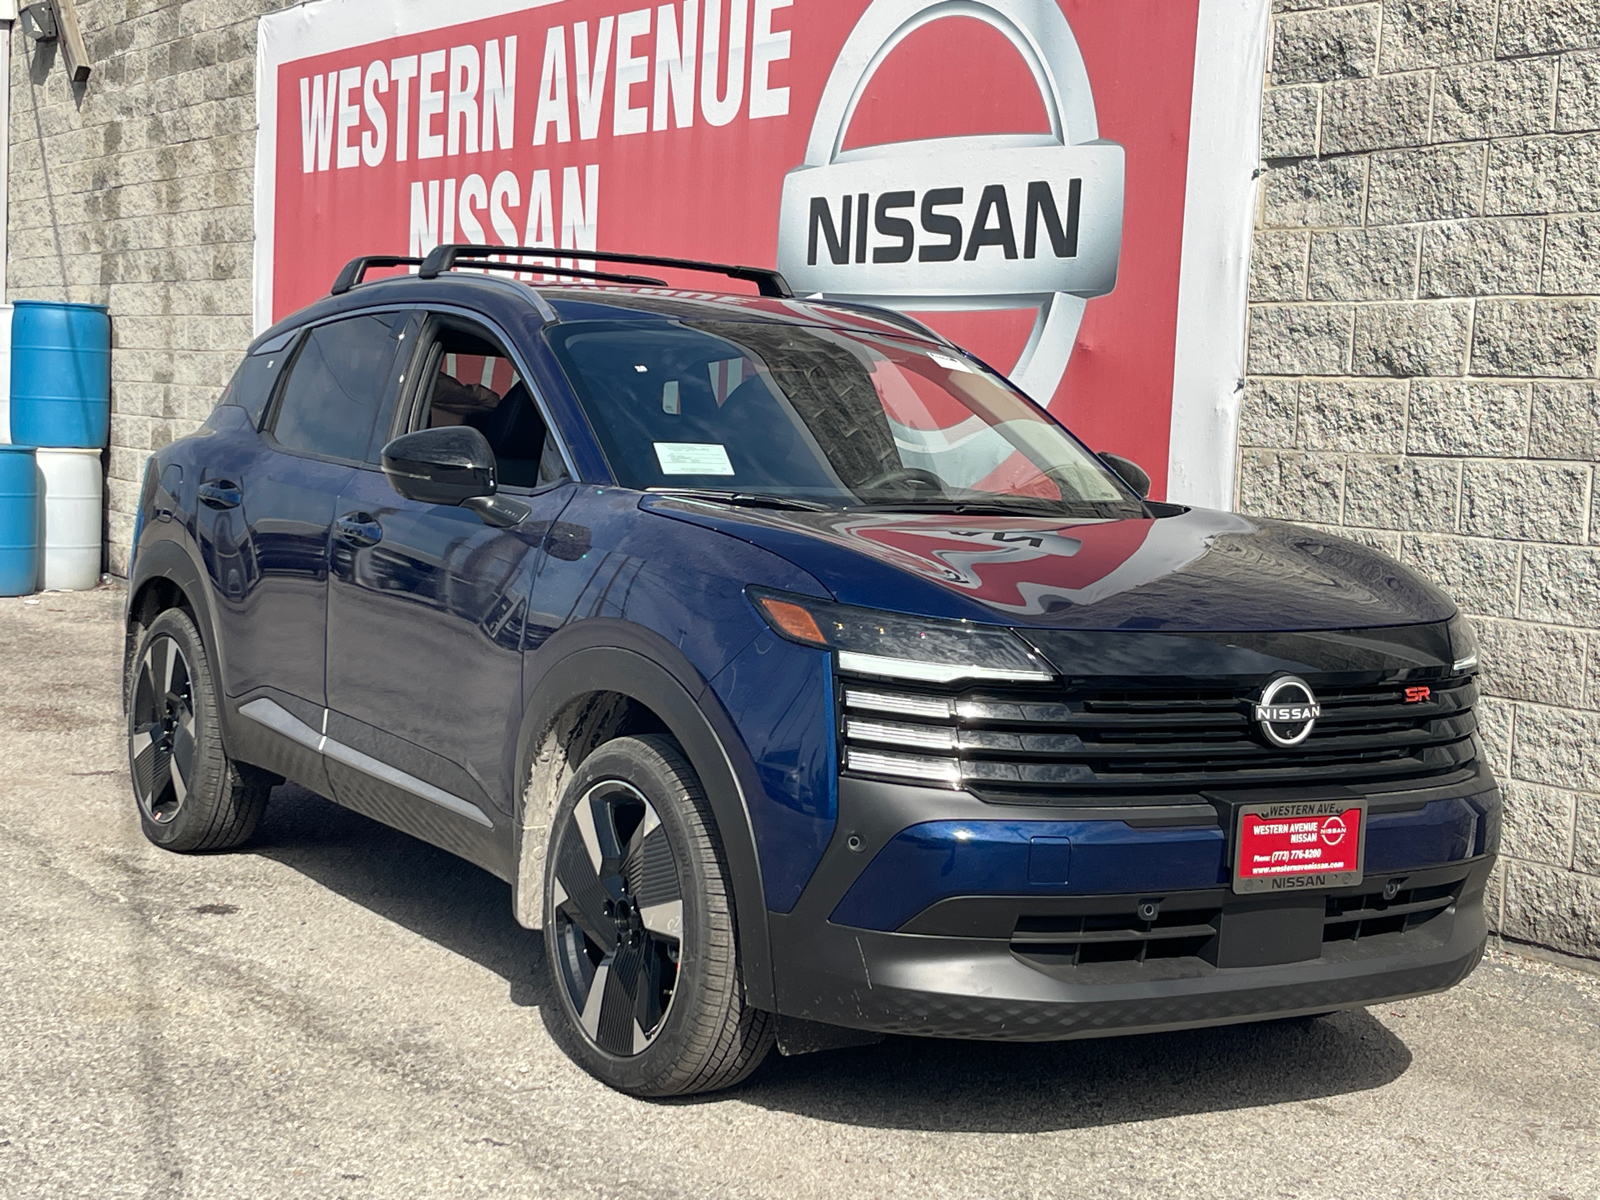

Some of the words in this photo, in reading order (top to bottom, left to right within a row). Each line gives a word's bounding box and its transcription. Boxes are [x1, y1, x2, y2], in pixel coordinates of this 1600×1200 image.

[300, 35, 517, 173] WESTERN
[532, 0, 794, 146] AVENUE
[409, 164, 599, 284] NISSAN
[807, 178, 1082, 266] NISSAN
[1404, 686, 1431, 702] SR
[1257, 705, 1320, 719] NISSAN
[1269, 804, 1315, 817] WESTERN
[1253, 824, 1288, 835] WESTERN
[1289, 822, 1318, 833] AVENUE
[1290, 833, 1317, 843] NISSAN
[1271, 851, 1289, 863] (773)
[1290, 848, 1321, 859] 776-8200
[1271, 875, 1325, 889] NISSAN
